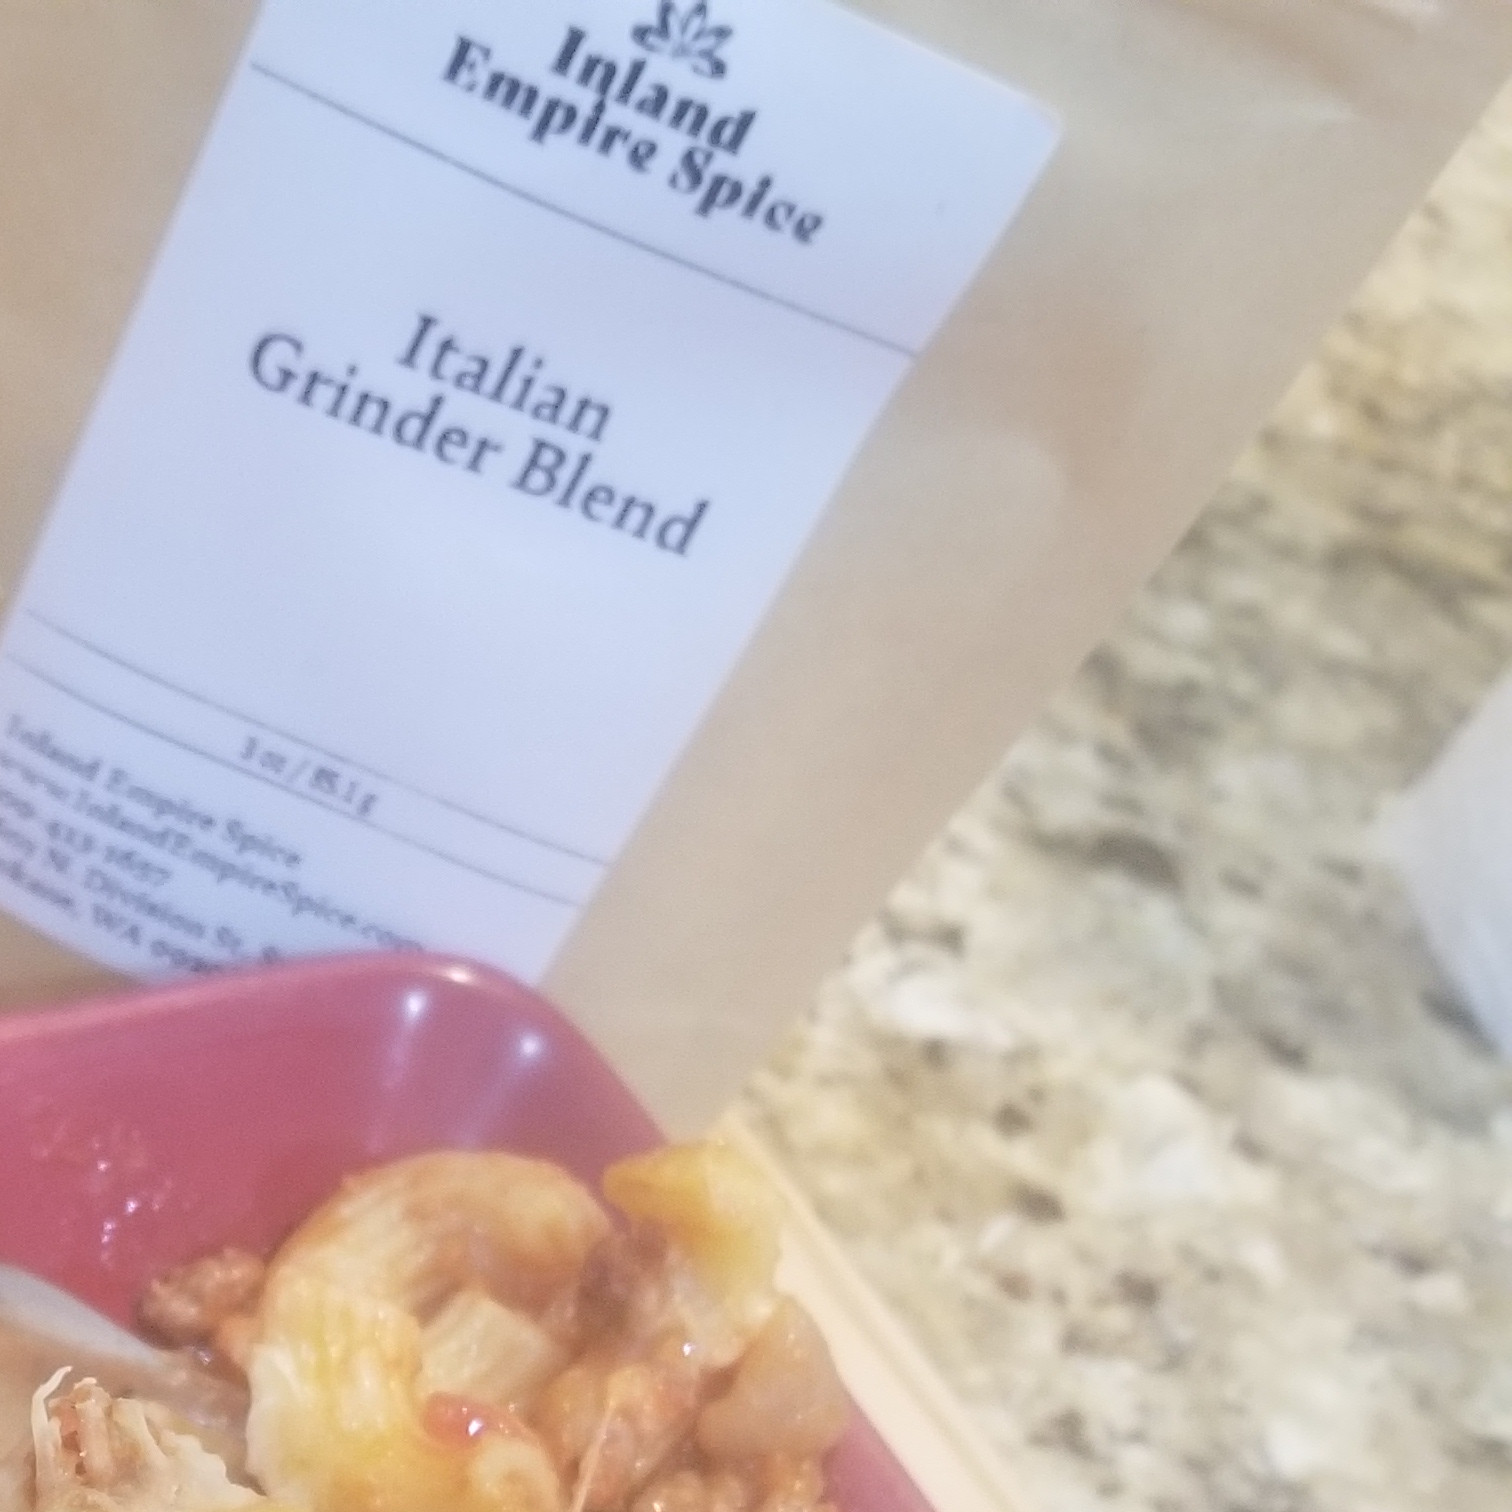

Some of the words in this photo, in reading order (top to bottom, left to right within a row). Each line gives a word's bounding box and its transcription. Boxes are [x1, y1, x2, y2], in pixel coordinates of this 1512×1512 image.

[441, 34, 658, 173] Empire
[668, 148, 825, 246] Spice
[550, 24, 755, 156] Inland
[248, 332, 502, 475] Grinder
[510, 437, 711, 556] Blend
[395, 314, 614, 443] Italian
[4, 712, 103, 783] Inland
[105, 766, 216, 831] Empire
[221, 818, 301, 867] Spice
